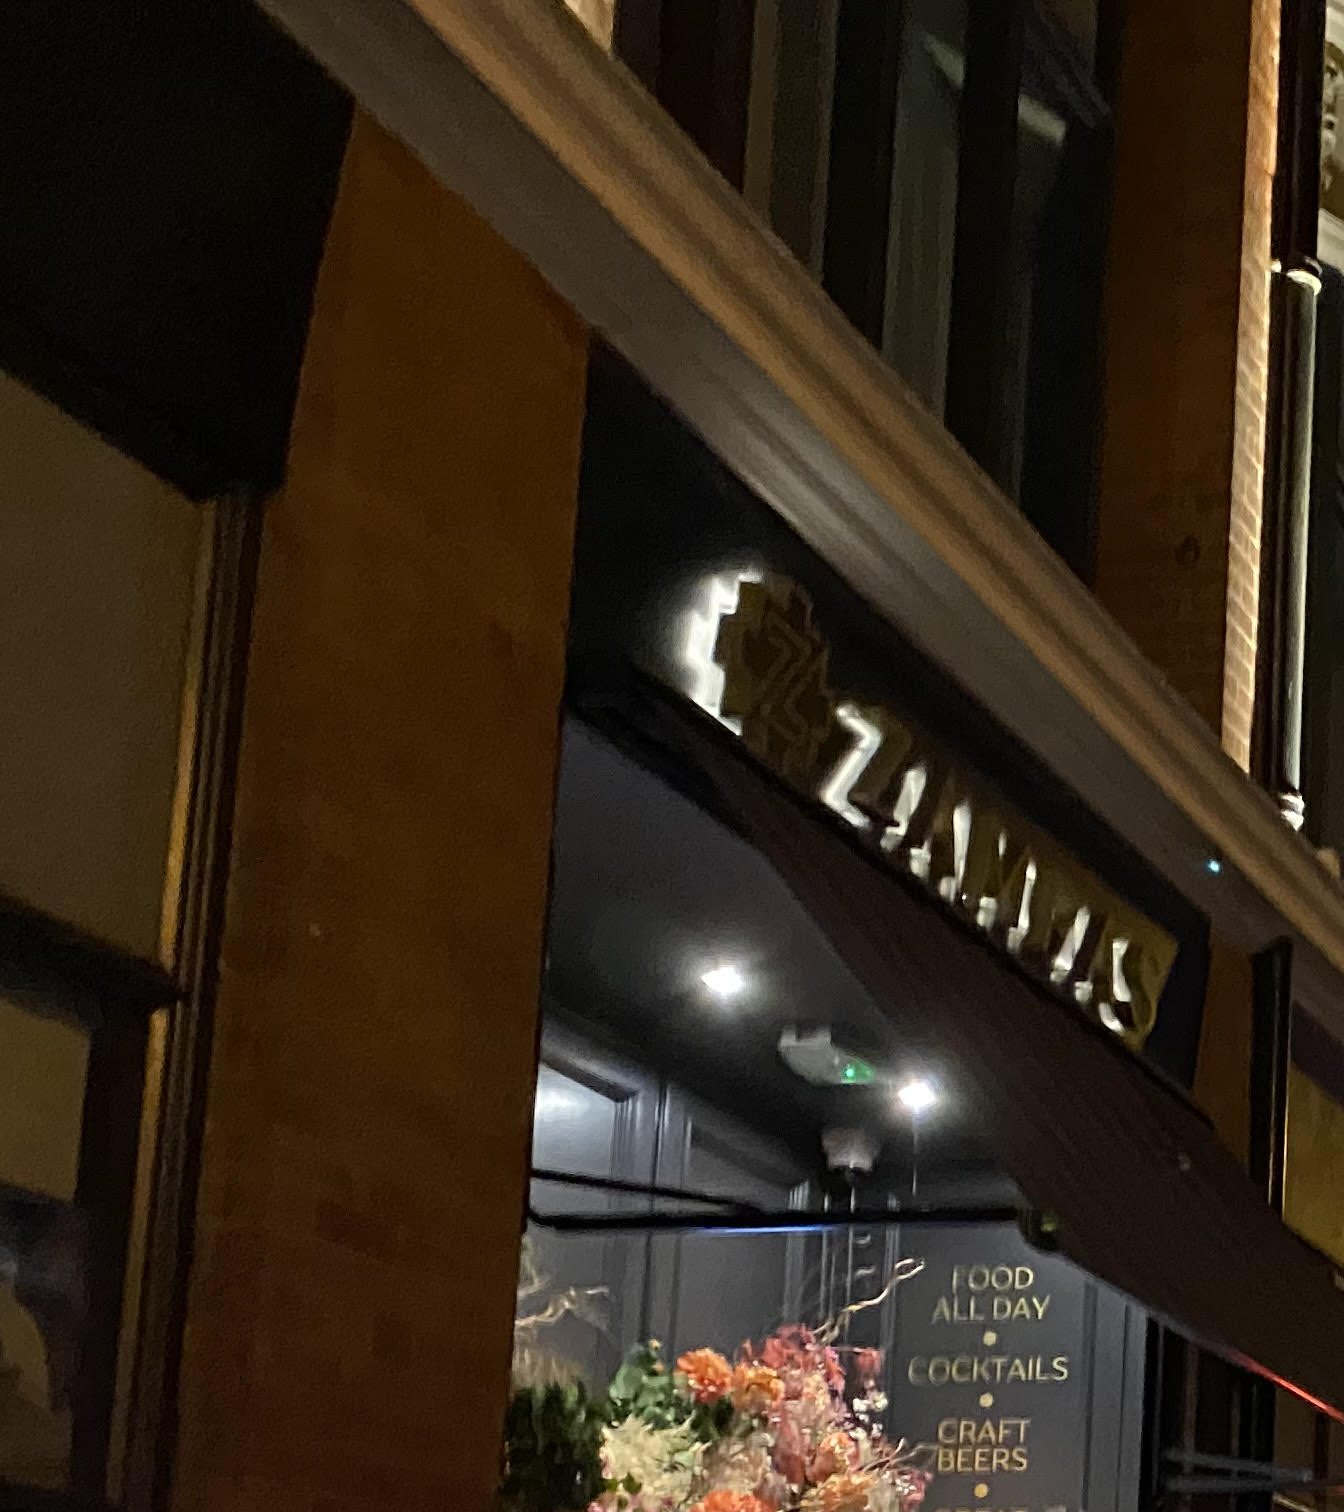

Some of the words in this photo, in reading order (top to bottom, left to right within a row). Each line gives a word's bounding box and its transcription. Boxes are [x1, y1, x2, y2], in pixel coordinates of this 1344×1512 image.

[952, 1266, 1034, 1292] FOOD
[933, 1298, 985, 1324] ALL
[993, 1296, 1050, 1320] DAY
[908, 1356, 1069, 1384] COCKTAILS
[938, 1419, 1031, 1444] CRAFT
[937, 1448, 1028, 1473] BEERS
